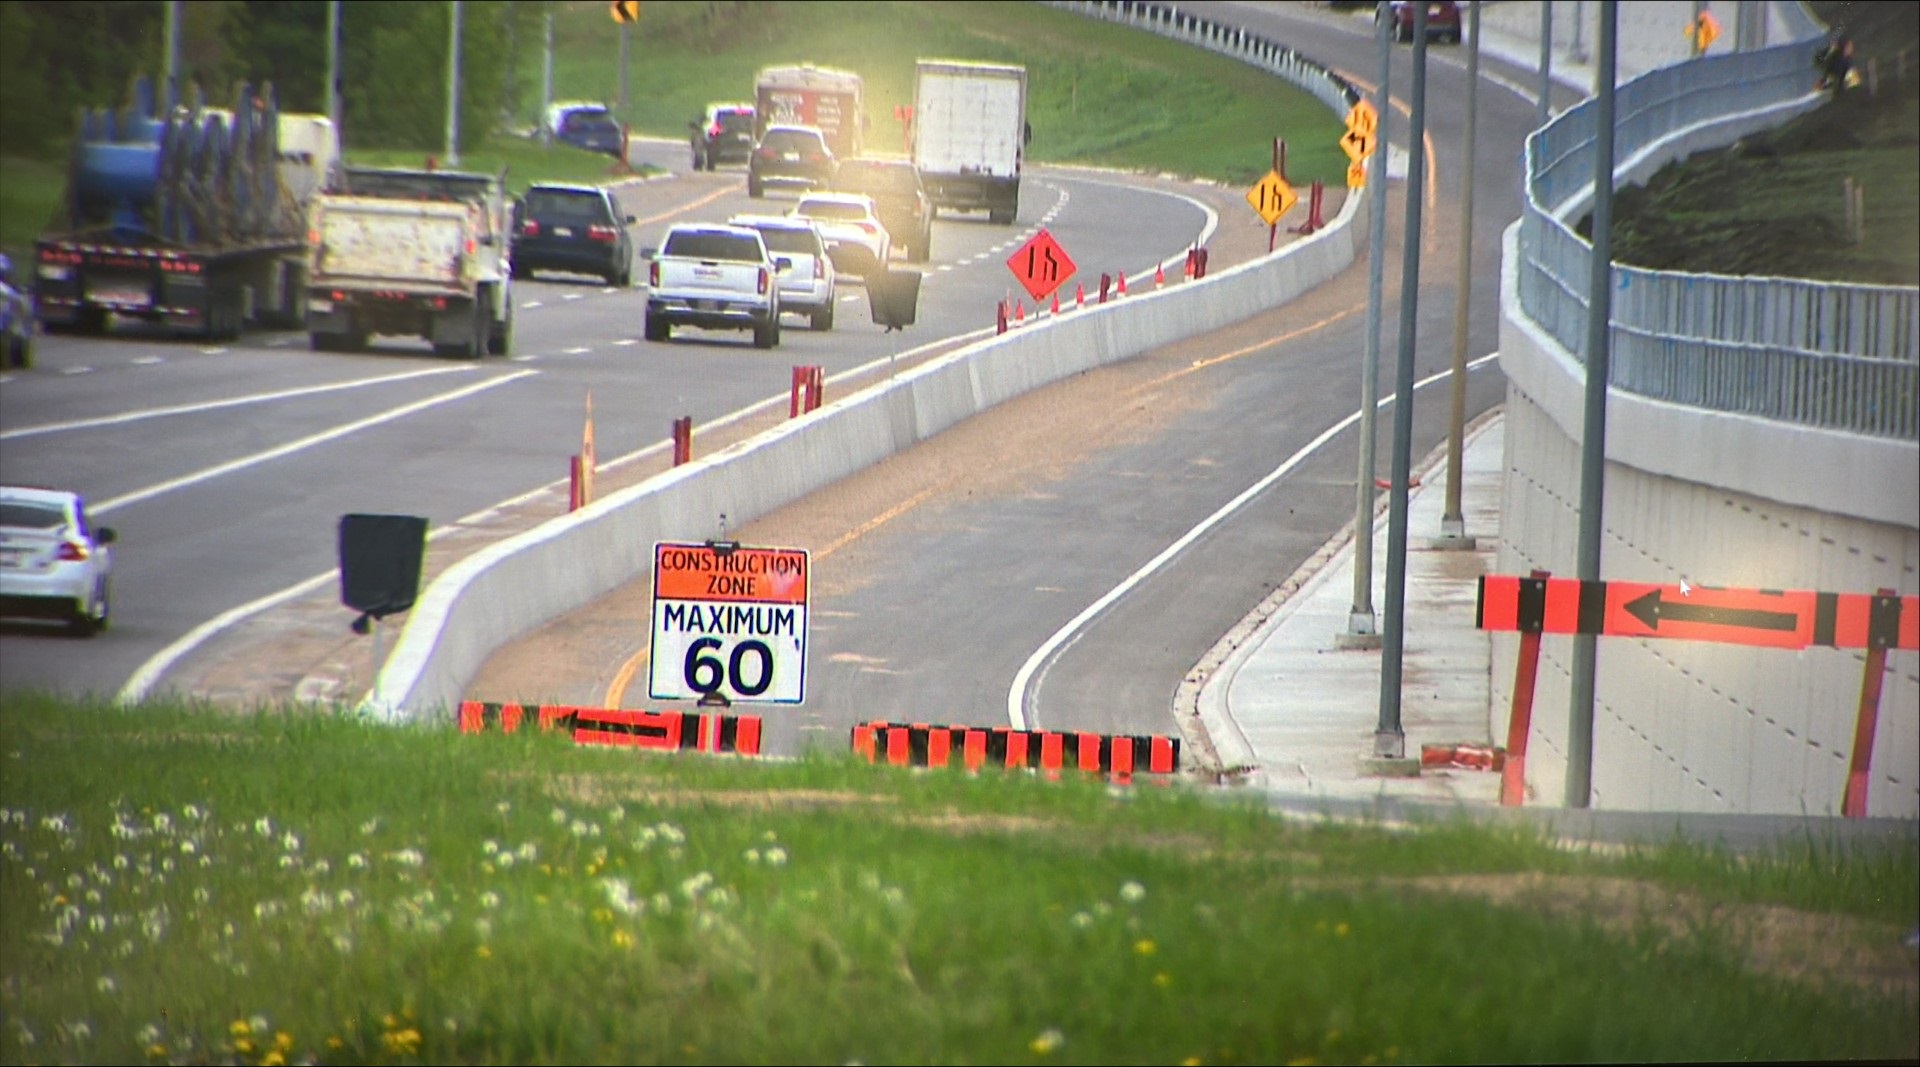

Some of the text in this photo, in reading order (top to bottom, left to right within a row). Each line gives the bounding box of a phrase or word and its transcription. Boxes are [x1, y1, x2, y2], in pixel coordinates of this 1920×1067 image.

[661, 551, 801, 576] CONSTRUCTION
[707, 576, 755, 595] ZONE
[664, 604, 794, 635] MAXIMUM
[684, 637, 773, 695] 60
